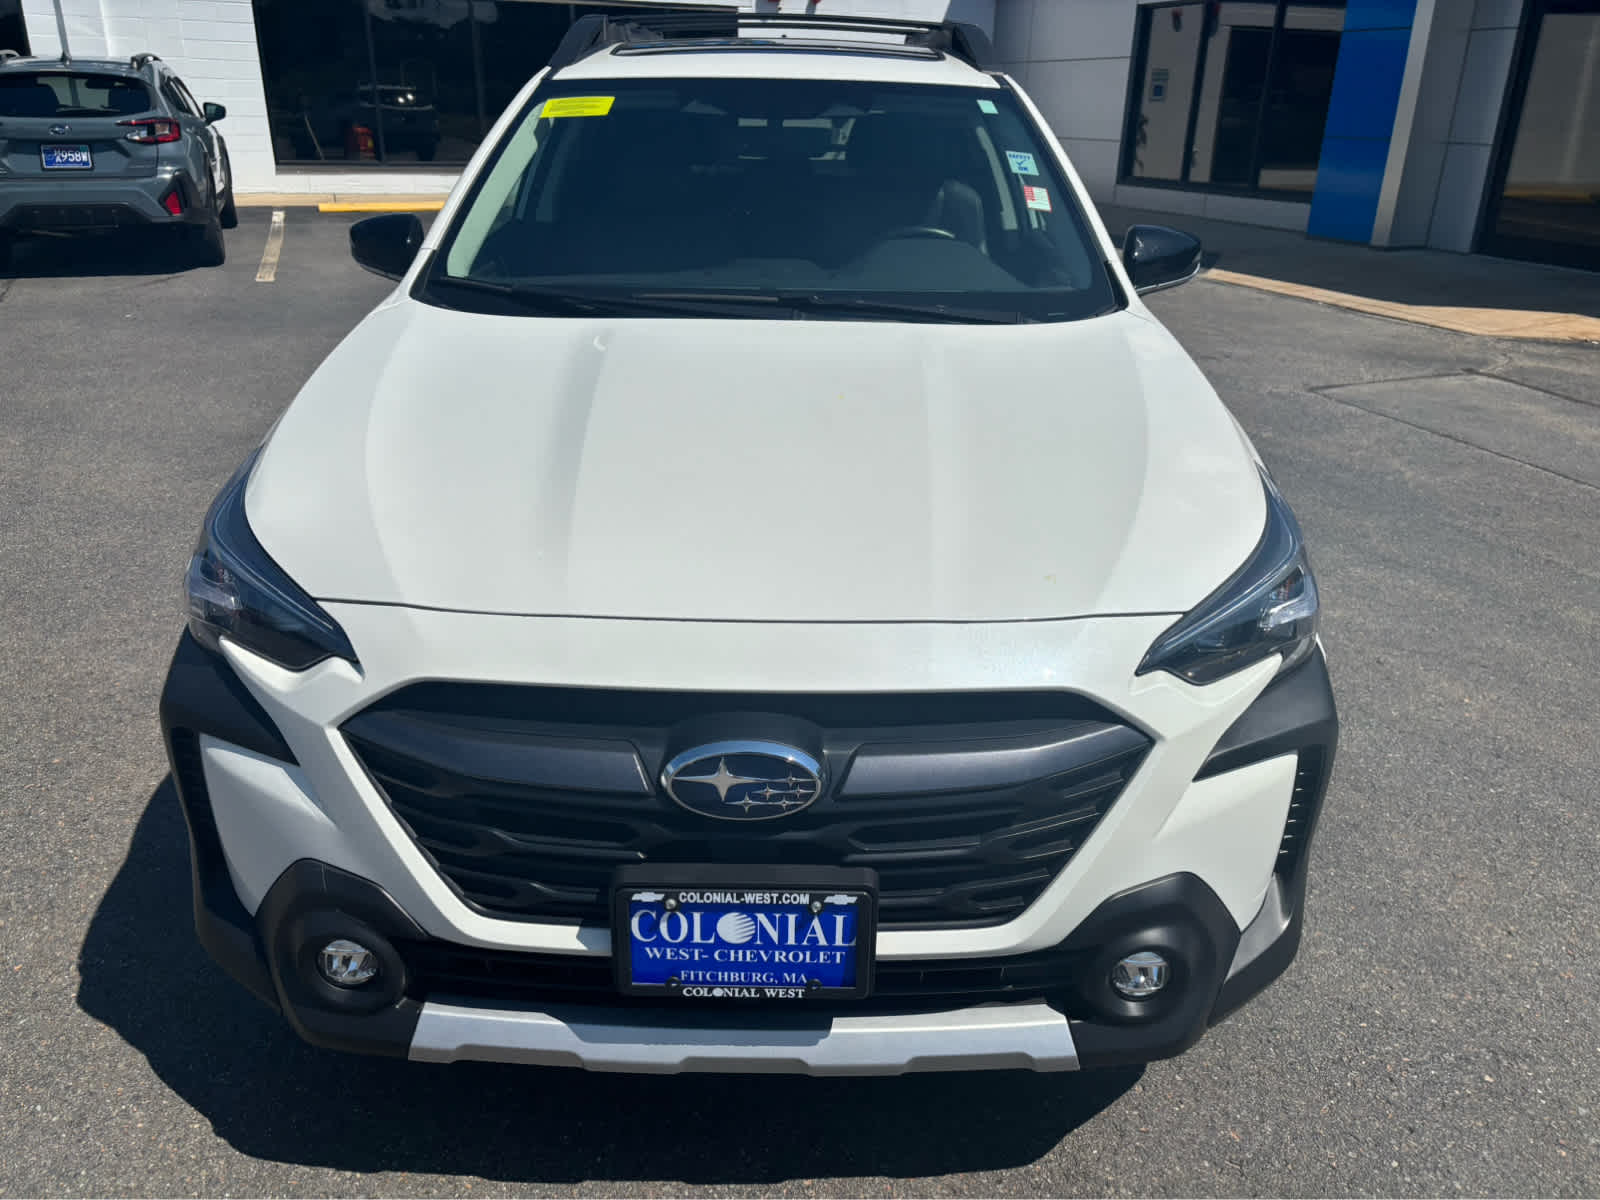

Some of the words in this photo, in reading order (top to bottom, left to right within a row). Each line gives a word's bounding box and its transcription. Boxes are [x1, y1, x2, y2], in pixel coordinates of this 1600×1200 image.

[678, 892, 810, 905] COLONIAL-WEST.COM
[631, 909, 857, 947] COLONIAL
[713, 949, 846, 964] CHEVROLET
[680, 970, 779, 984] FITCHBURG,
[782, 972, 808, 984] MA
[682, 987, 760, 998] COLONIAL
[764, 988, 806, 999] WEST
